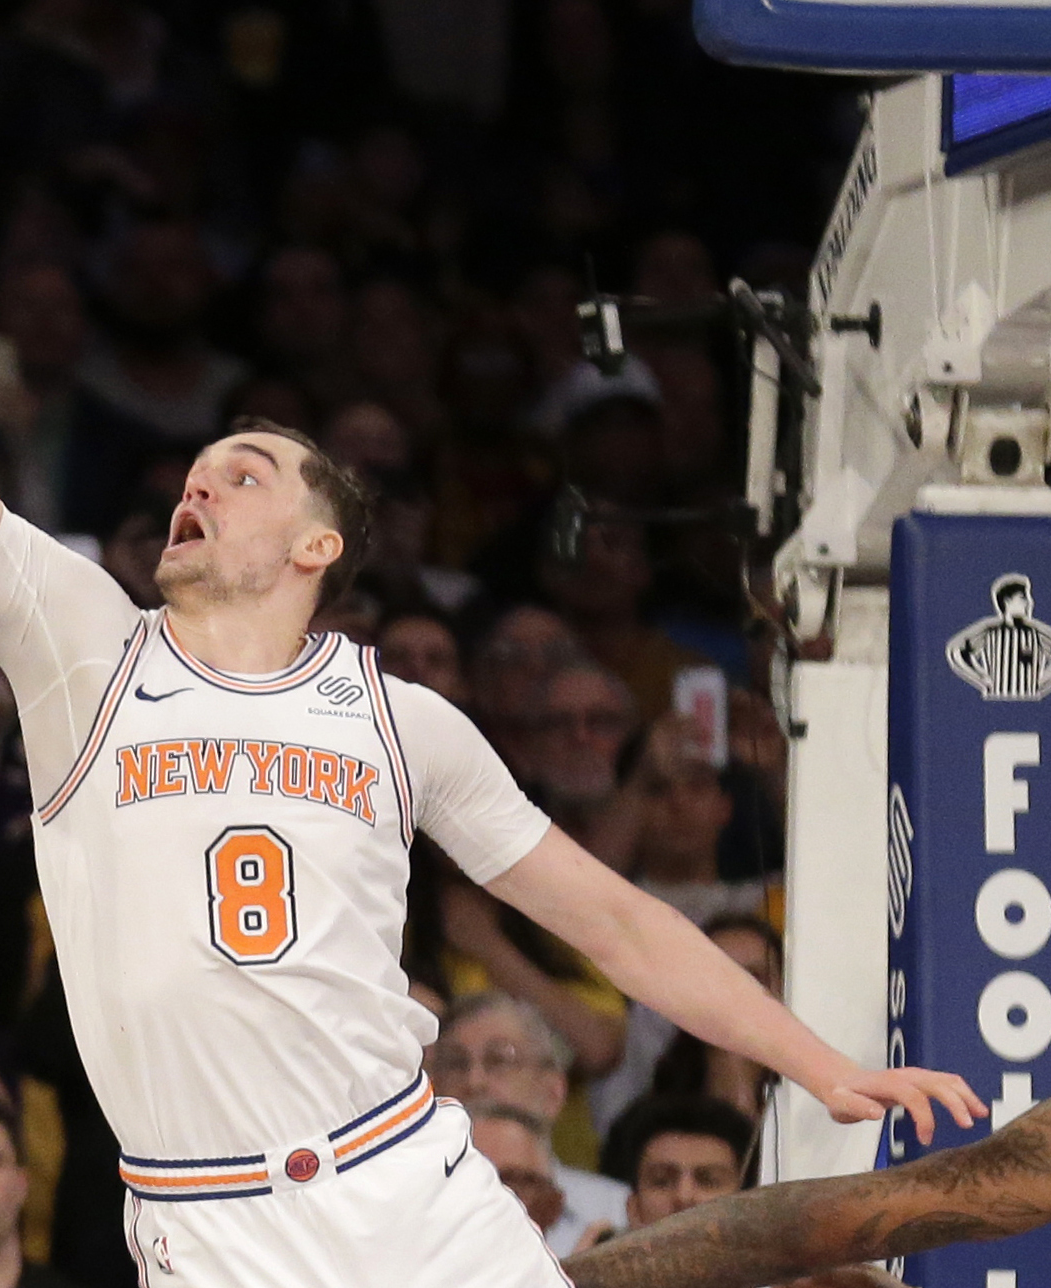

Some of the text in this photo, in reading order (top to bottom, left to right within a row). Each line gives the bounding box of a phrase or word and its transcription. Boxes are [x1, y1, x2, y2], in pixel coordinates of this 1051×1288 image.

[115, 738, 380, 826] NEW YORK
[204, 824, 299, 967] 8
